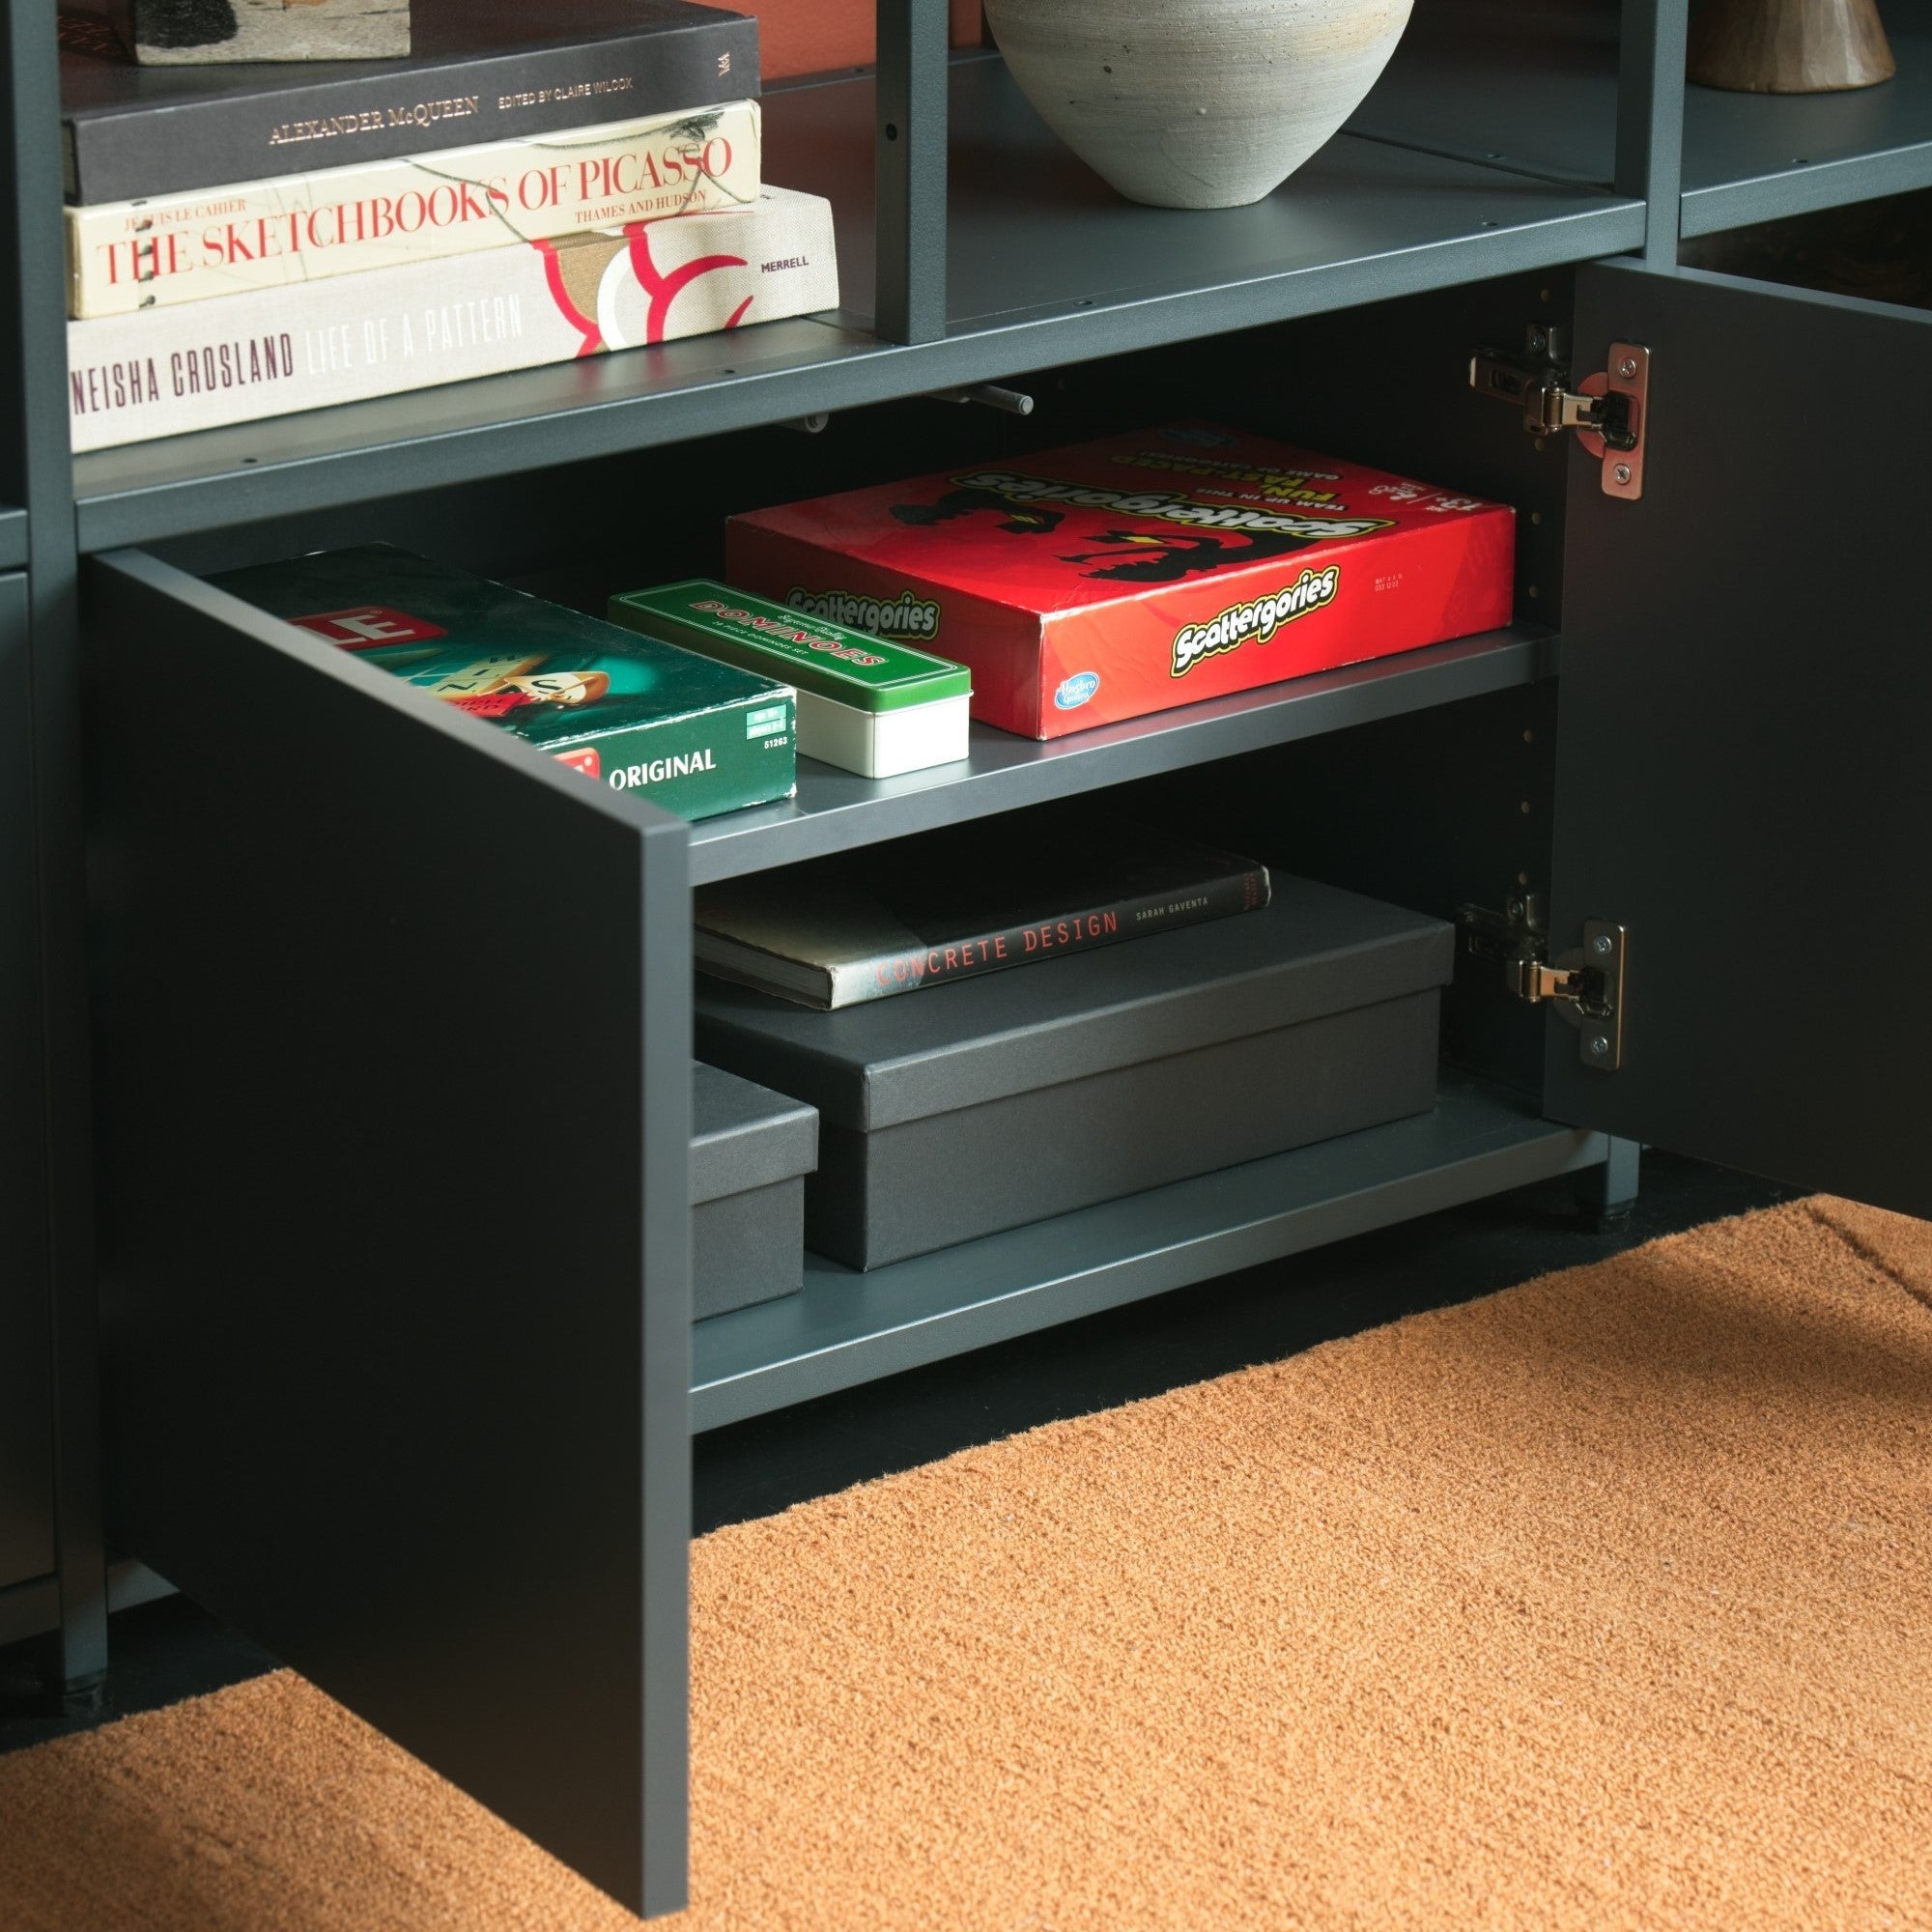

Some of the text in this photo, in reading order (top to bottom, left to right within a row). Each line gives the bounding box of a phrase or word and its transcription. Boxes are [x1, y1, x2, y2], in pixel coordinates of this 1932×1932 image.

[498, 76, 633, 109] EDITED BY CLAIRE WILCOX
[269, 96, 479, 145] ALEXANDER McQUEEN
[97, 136, 732, 284] THE SKETCHBOOKS OF PICASSO
[175, 208, 191, 222] LE
[195, 197, 246, 218] CAHIER
[575, 189, 706, 224] THAMES AND HUDSON
[761, 256, 809, 273] MERRELL
[71, 293, 523, 415] NEISHA CROSLAND LIFE OF A PATTERN
[959, 472, 1381, 537] Scattergories
[1296, 500, 1346, 512] TEAM
[690, 600, 888, 667] DOMINOES
[1174, 568, 1337, 671] Scattergories
[764, 737, 788, 750] 51263
[609, 749, 717, 791] ORIGINAL
[1136, 896, 1208, 921] SARAH GAVENTA
[876, 911, 1118, 985] CONCRETE DESIGN
